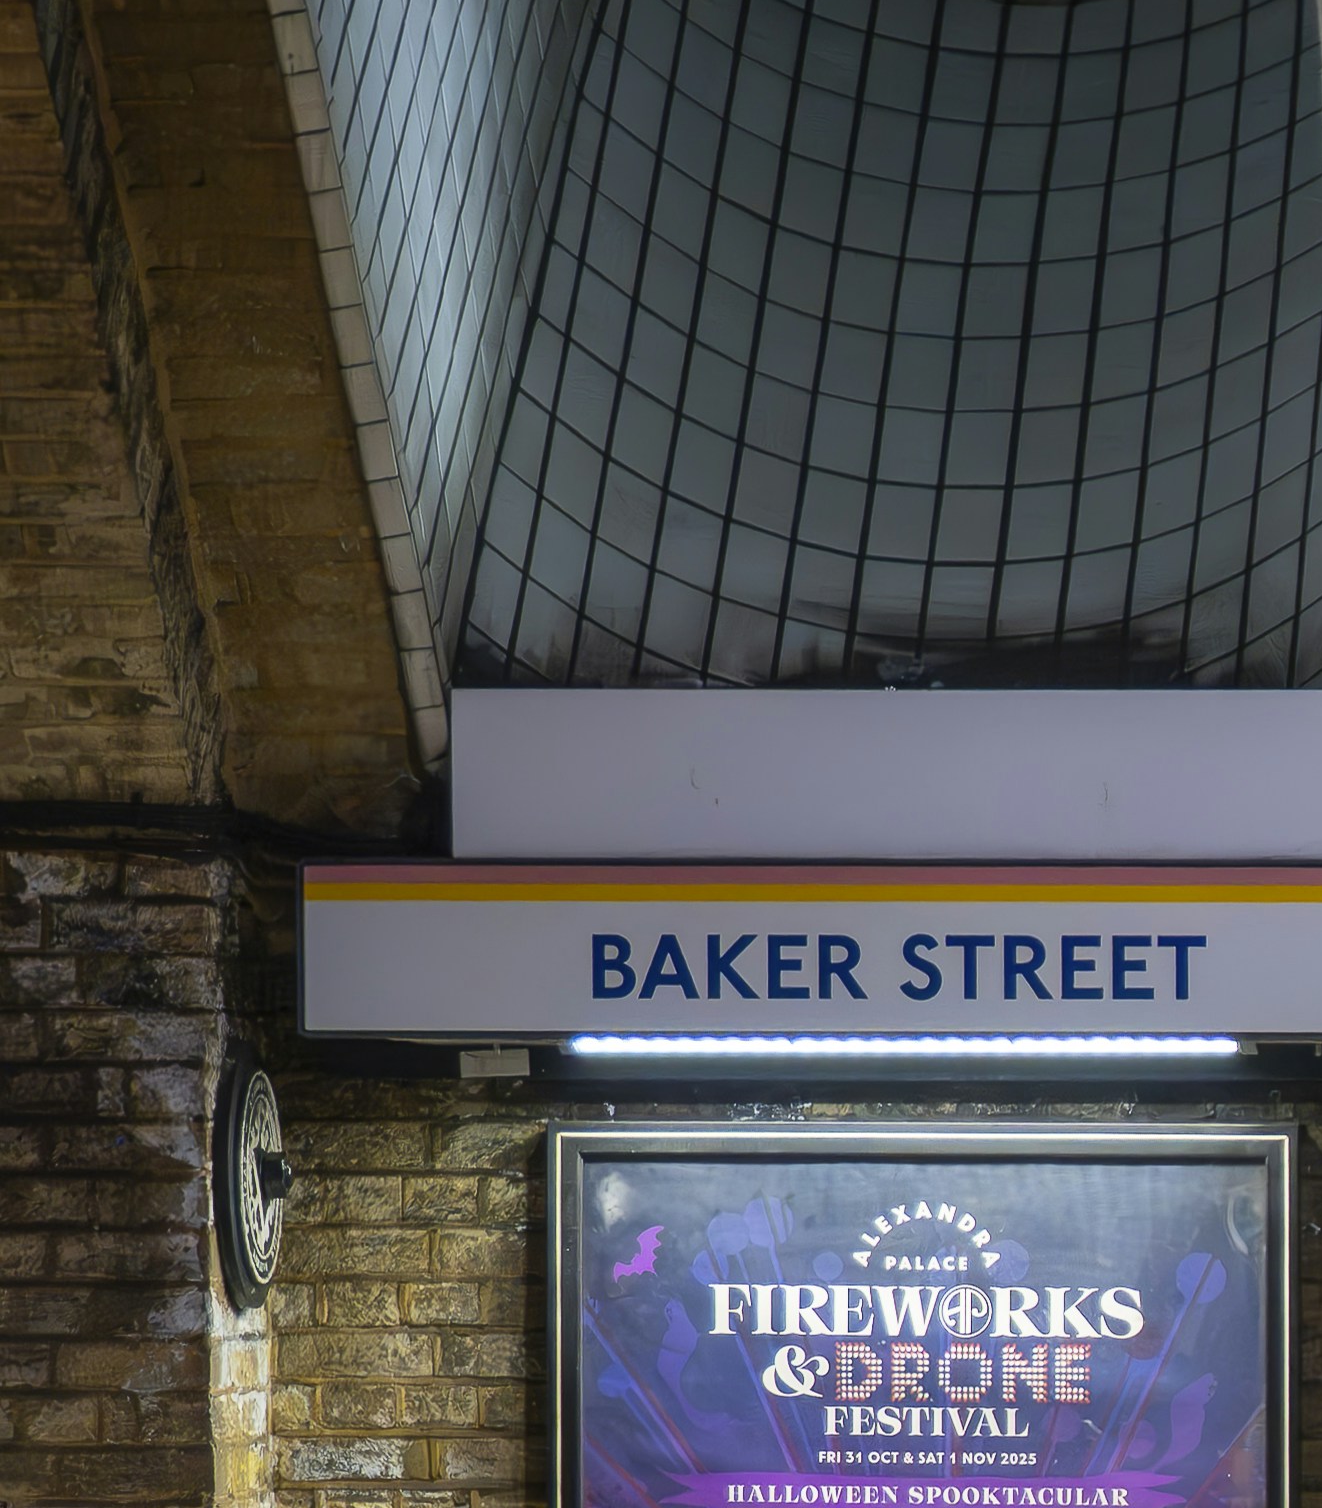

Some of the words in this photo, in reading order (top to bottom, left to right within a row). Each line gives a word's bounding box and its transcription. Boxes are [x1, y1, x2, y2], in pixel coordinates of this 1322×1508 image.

[591, 933, 868, 1000] BAKER
[899, 933, 1207, 1001] STREET
[852, 1200, 1001, 1269] ALEXANDRA
[884, 1255, 968, 1272] PALACE
[762, 1345, 830, 1398] &
[834, 1341, 1093, 1403] DRONE
[823, 1406, 1030, 1437] FESTIVAL
[818, 1450, 841, 1464] FRI
[845, 1451, 862, 1464] 31
[867, 1451, 900, 1464] OCT
[903, 1451, 914, 1464] &
[918, 1451, 945, 1465] SAT
[949, 1452, 956, 1465] 1
[962, 1452, 997, 1465] NOV
[1000, 1452, 1037, 1465] 2025
[727, 1484, 899, 1504] HALLOWEEN
[908, 1486, 1129, 1507] SPOOKTACULAR
